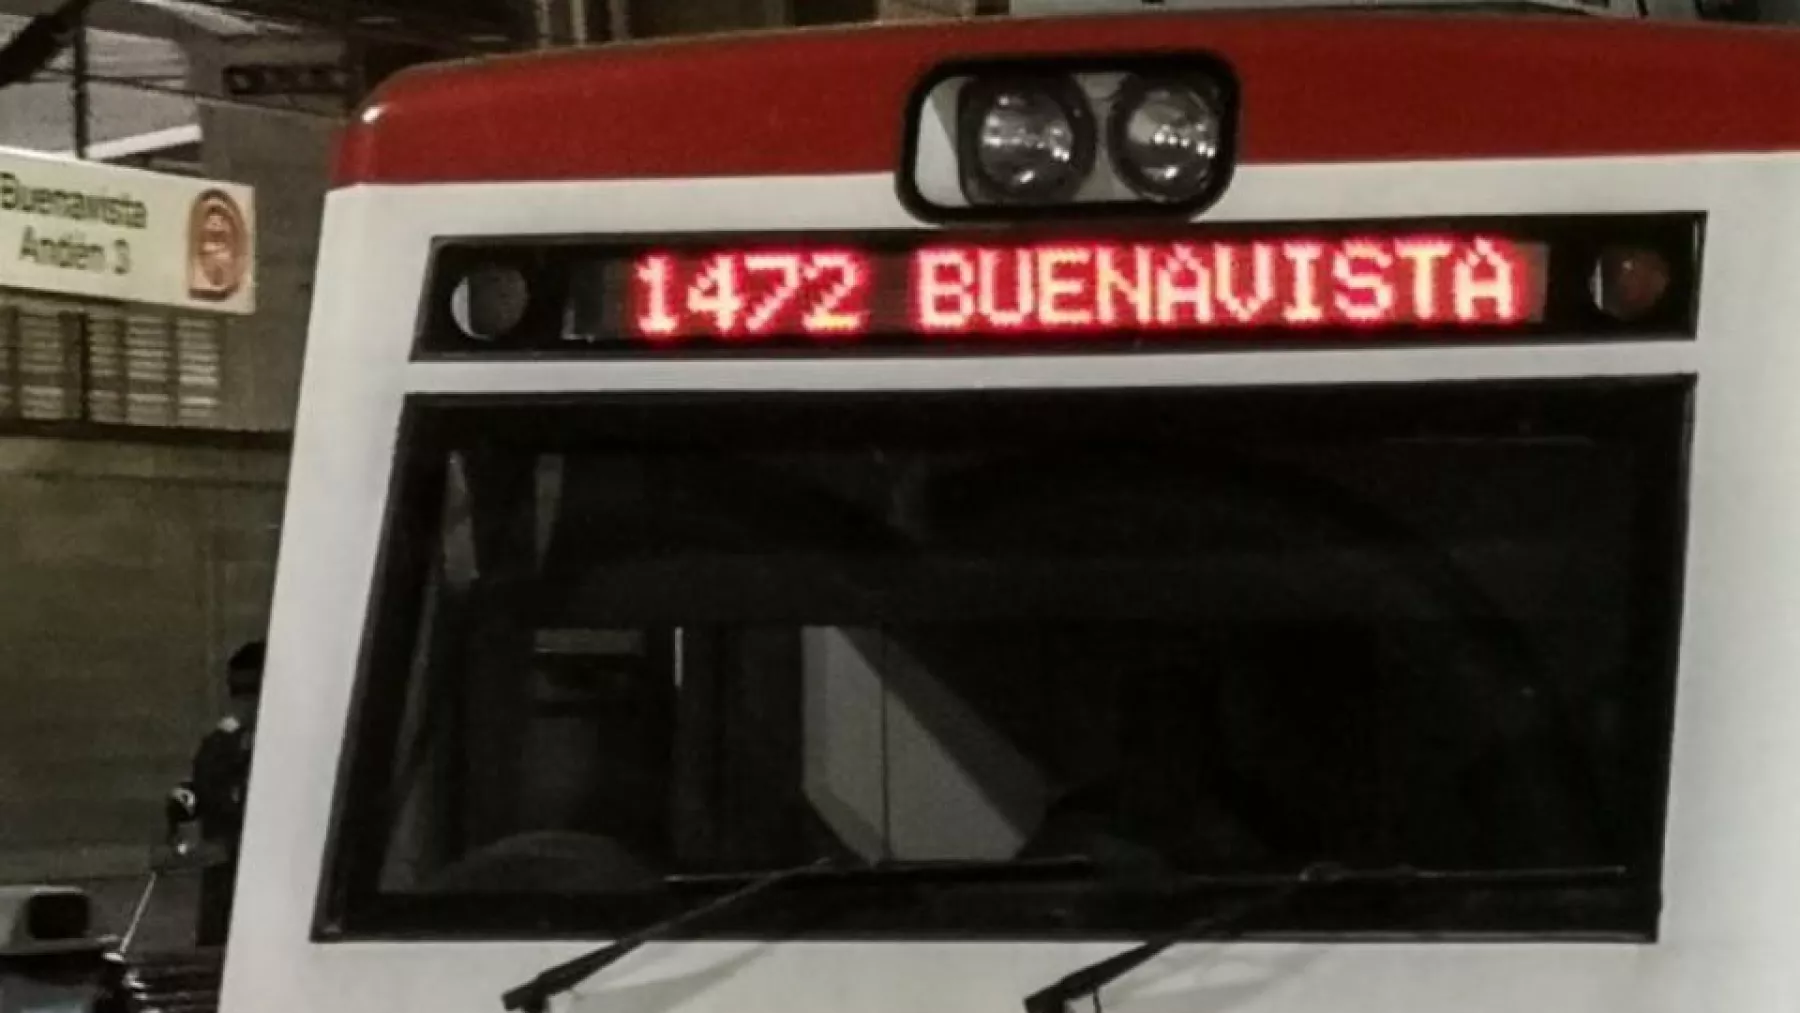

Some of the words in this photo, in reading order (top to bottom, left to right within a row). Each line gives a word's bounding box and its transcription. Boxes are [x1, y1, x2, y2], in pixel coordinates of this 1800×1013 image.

[0, 171, 147, 229] Buenavista
[634, 253, 864, 335] 1472
[914, 236, 1518, 333] BUENAVISTA
